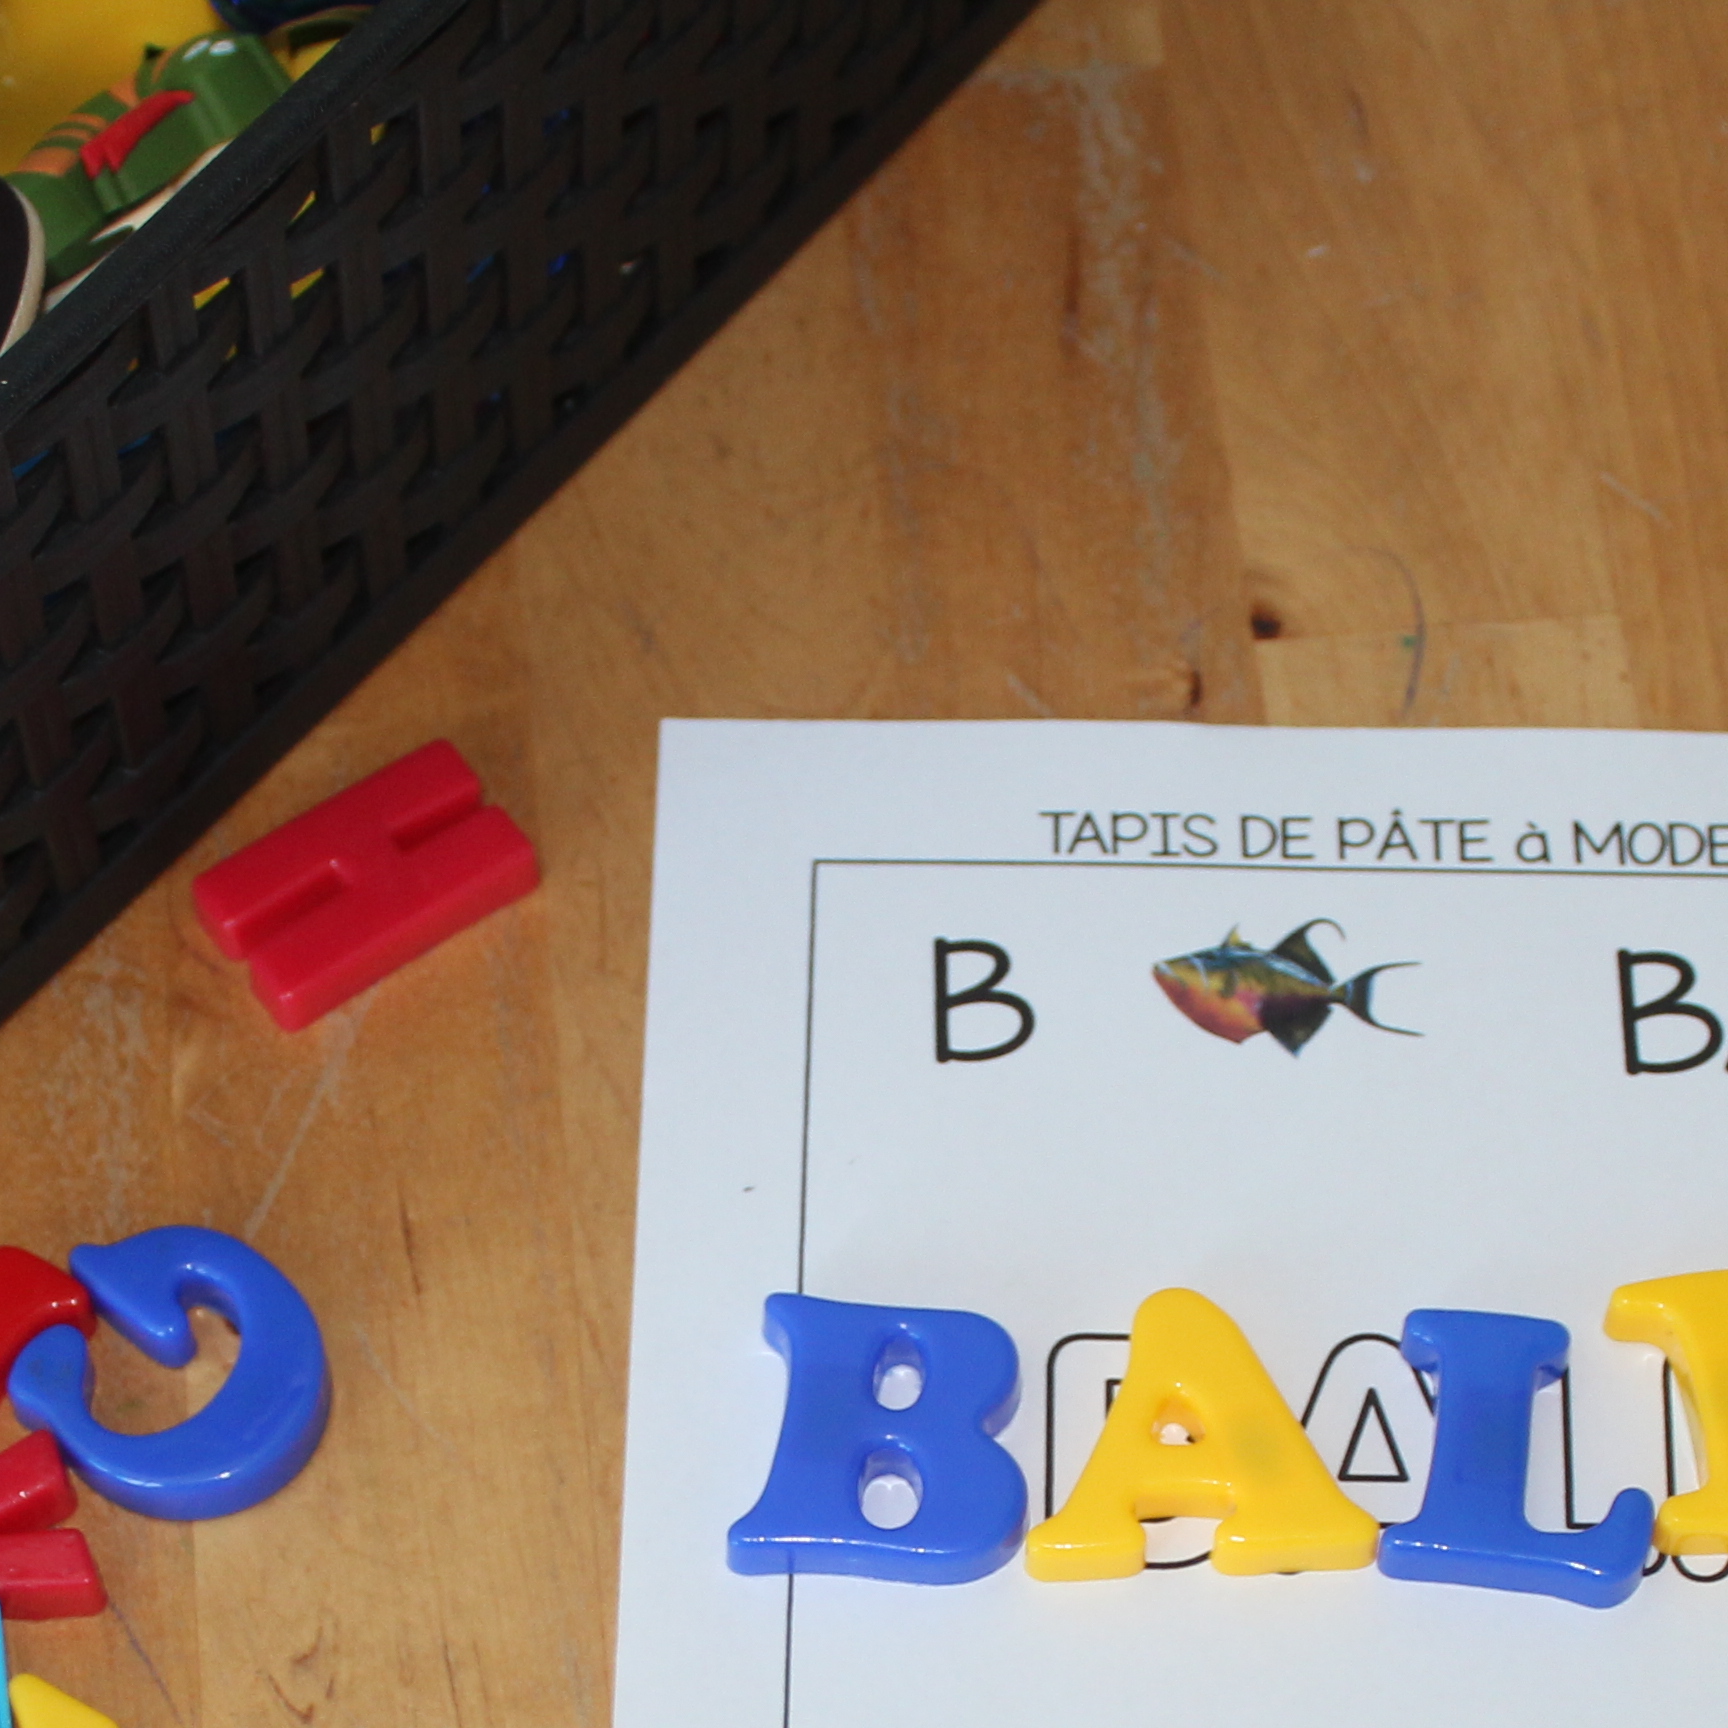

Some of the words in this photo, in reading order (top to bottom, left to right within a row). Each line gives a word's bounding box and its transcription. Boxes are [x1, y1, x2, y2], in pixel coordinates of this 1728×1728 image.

[1039, 810, 1219, 858] TAPIS
[1240, 814, 1315, 861] DE
[1336, 808, 1494, 864] PÂTE
[1515, 821, 1552, 864] à
[932, 936, 1036, 1064] B
